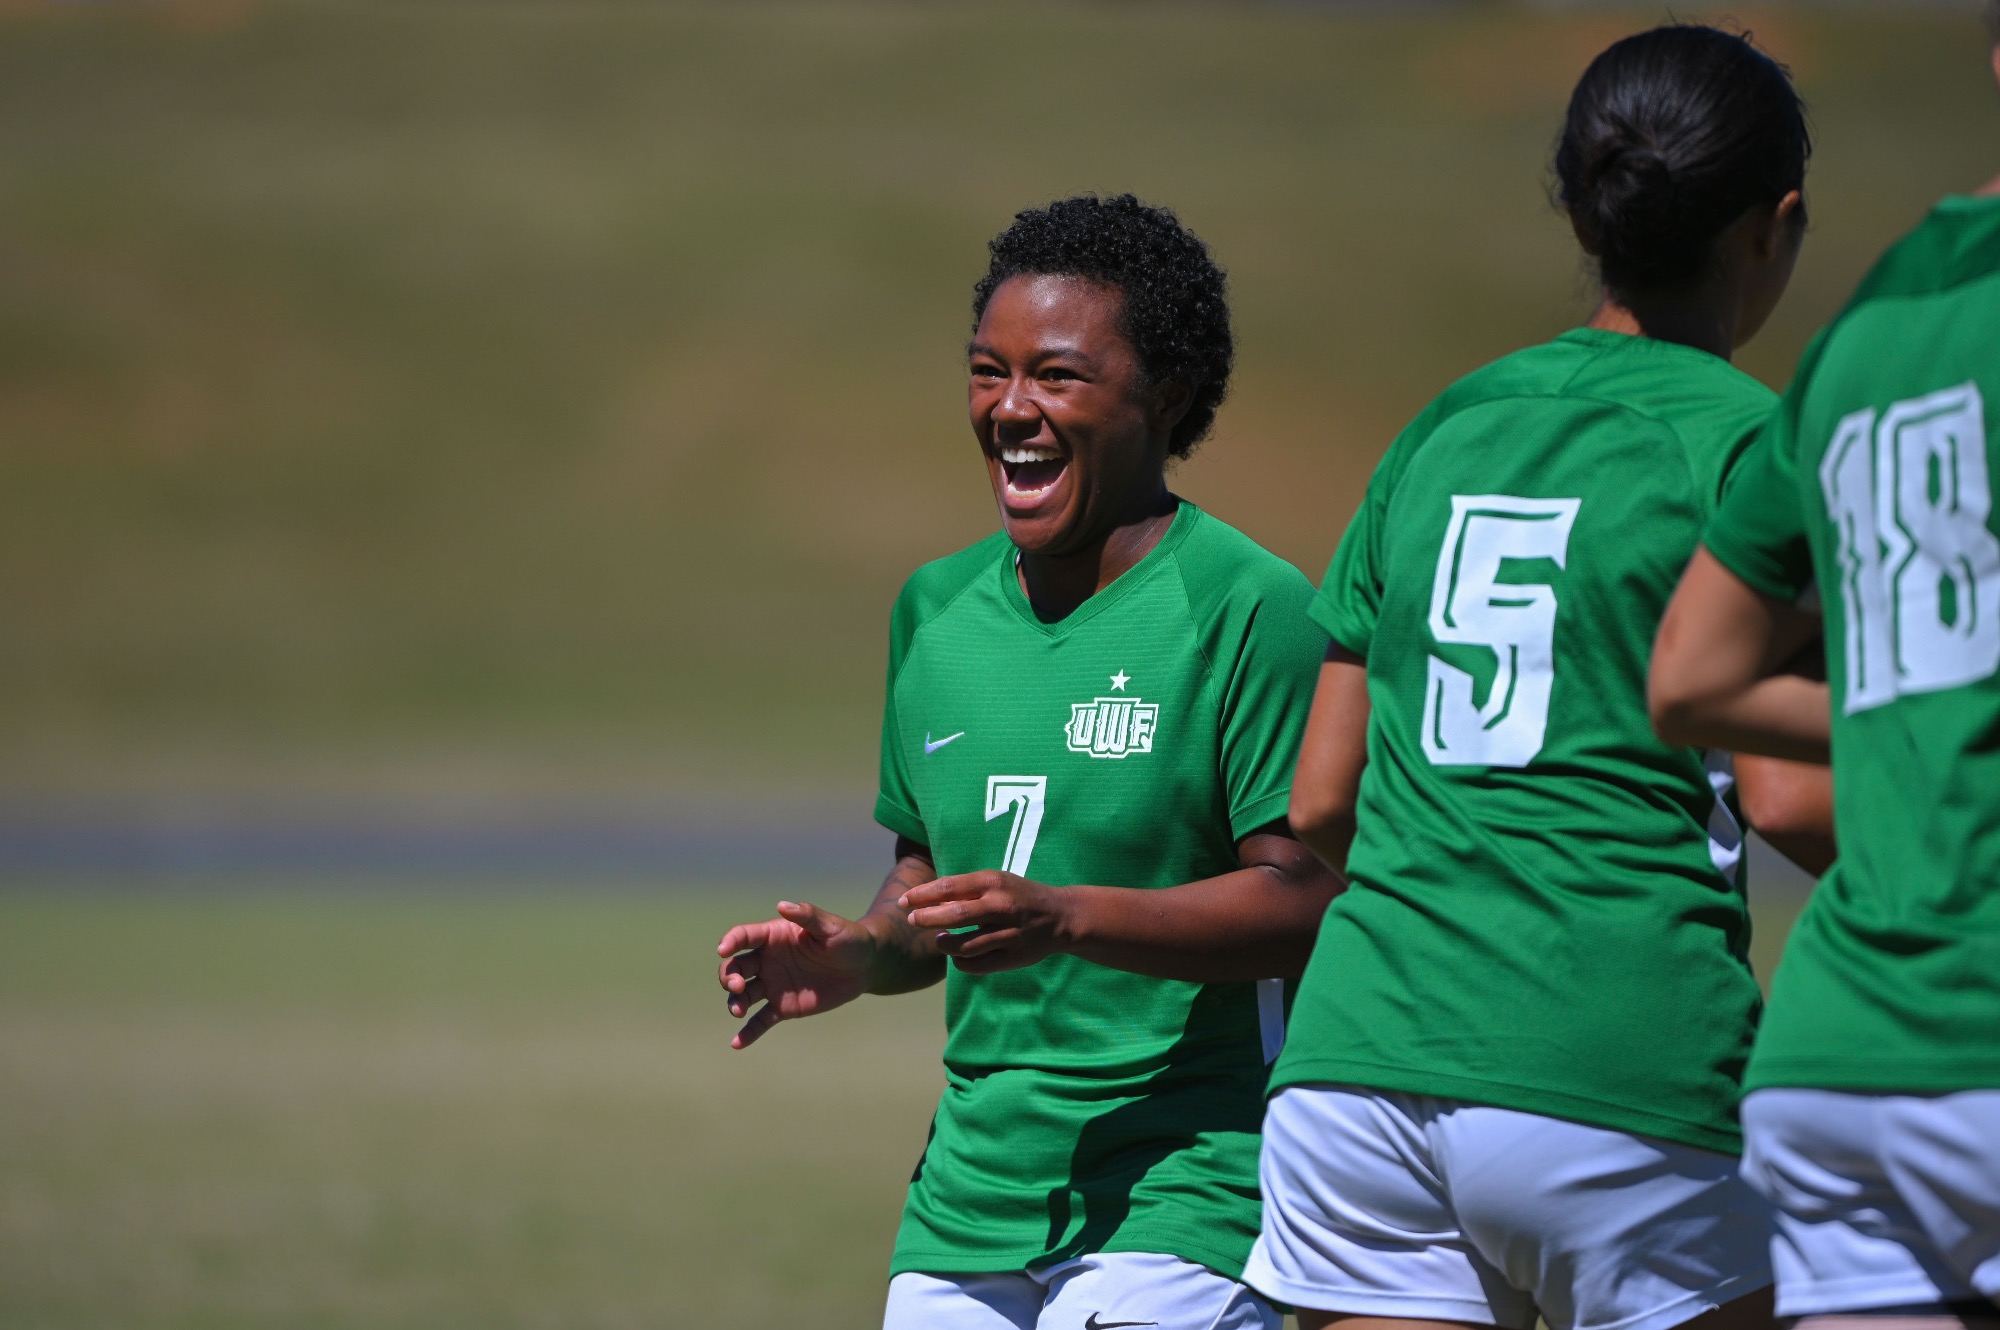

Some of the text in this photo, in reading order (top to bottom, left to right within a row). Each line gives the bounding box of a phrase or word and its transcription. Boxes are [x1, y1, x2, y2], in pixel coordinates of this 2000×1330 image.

[1421, 494, 1582, 767] 5
[1820, 381, 2000, 716] 18
[1070, 701, 1156, 754] UWF
[985, 775, 1047, 877] 7
